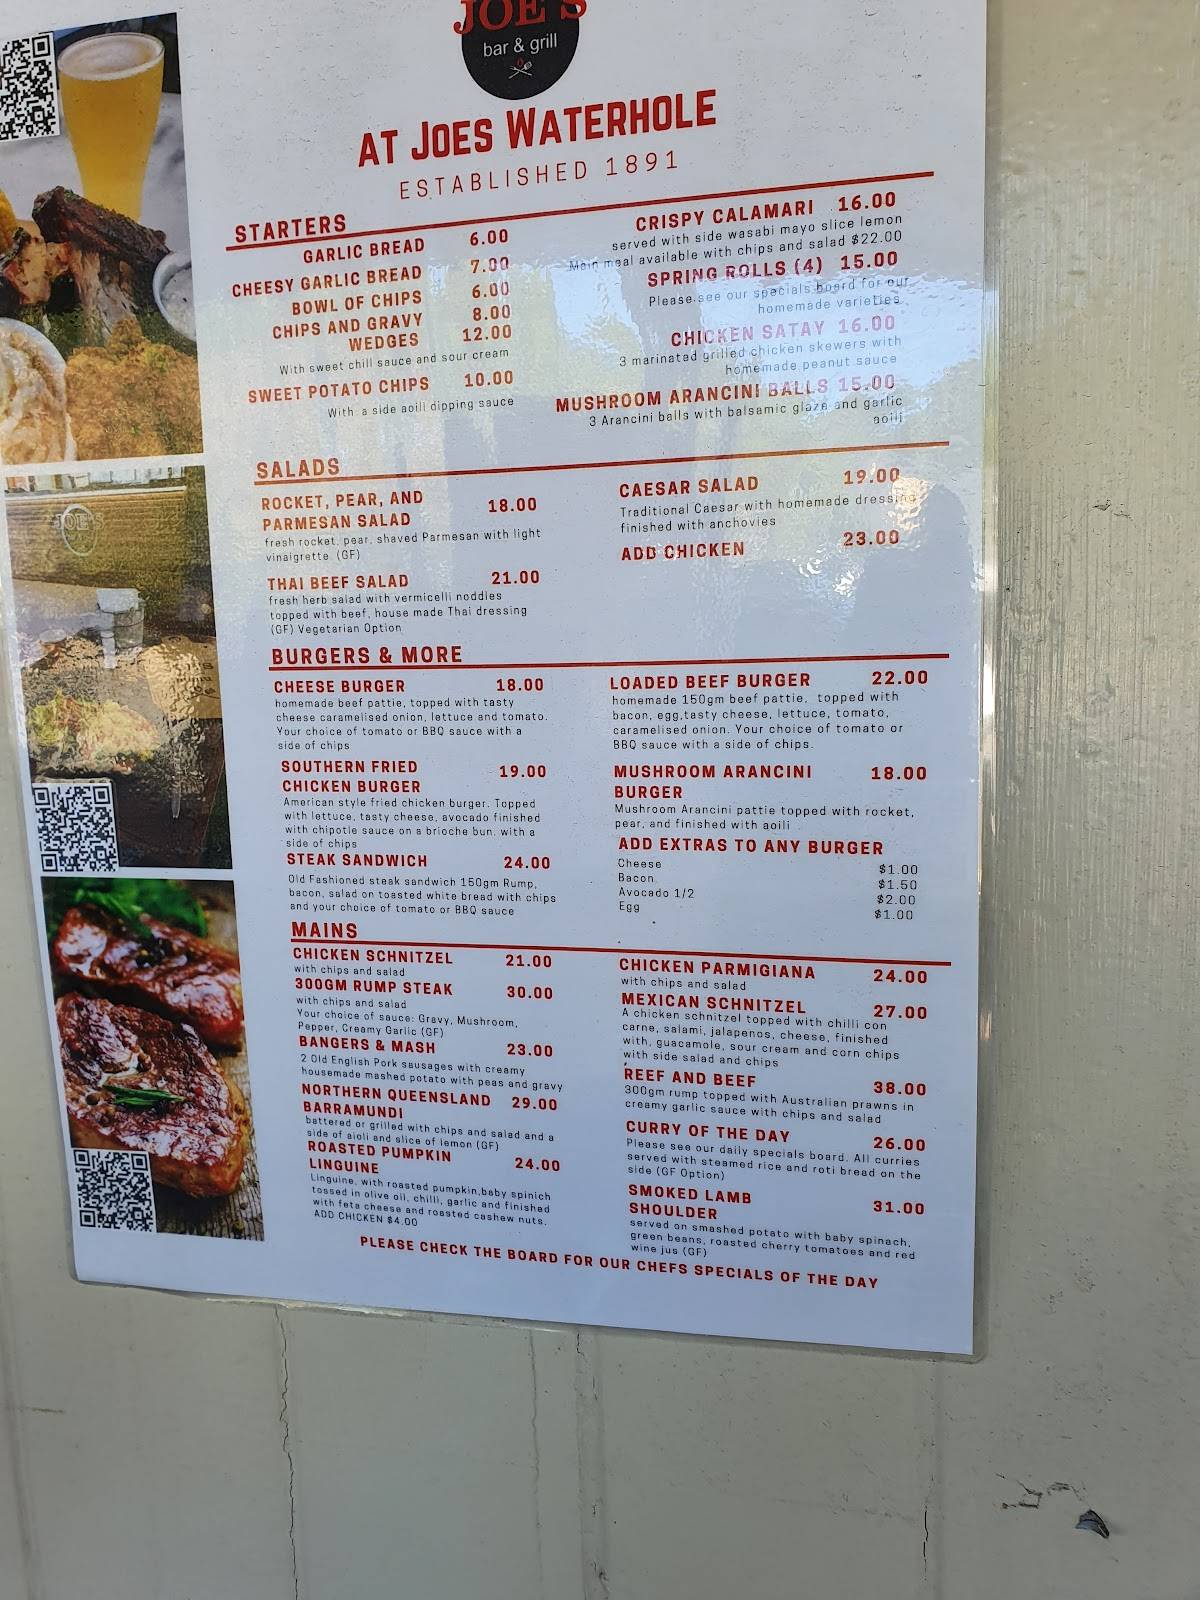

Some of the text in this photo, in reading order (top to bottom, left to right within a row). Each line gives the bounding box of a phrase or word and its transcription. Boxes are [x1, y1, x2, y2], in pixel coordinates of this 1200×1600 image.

[483, 33, 557, 57] bar & grill
[358, 130, 398, 167] AT
[399, 150, 679, 200] ESTABLISHED 1891
[635, 191, 896, 232] CRISPY CALAMARI 16.00
[235, 213, 346, 244] STARTERS
[612, 215, 902, 251] served with side wasabi mayo slice lemon
[303, 228, 508, 264] GARLIC BREAD 6.00
[232, 256, 509, 298] CHEESY GARLIC BREAD 7.00
[647, 250, 898, 288] SPRING ROLLS (4) 15.00
[292, 281, 510, 316] BOWL OF CHIPS 6.00
[272, 304, 511, 340] CHIPS AND GRAVY 8.00
[671, 313, 895, 347] CHICKEN SATAY 16.00
[348, 324, 512, 352] WEDGES 12.00
[279, 349, 509, 376] With sweet chill sauce and sour cream
[248, 369, 513, 404] SWEET POTATO CHIPS 10.00
[256, 457, 340, 480] SALADS
[619, 467, 900, 498] CAESAR SALAD 19.00
[261, 490, 537, 513] ROCKET, PEAR, AND 18.00
[263, 512, 411, 532] PARMESAN SALAD
[620, 516, 776, 534] finished with anchovies
[267, 570, 540, 591] THAI BEEF SALAD 21.00
[270, 609, 309, 622] topped
[312, 608, 337, 619] with
[374, 607, 409, 618] house
[413, 606, 444, 617] made
[447, 606, 472, 617] Thai
[476, 605, 527, 617] dressing
[271, 645, 462, 665] BURGERS & MORE
[274, 677, 544, 694] CHEESE BURGER 18.00
[610, 670, 928, 690] LOADED BEEF BURGER 22.00
[276, 712, 316, 722] cheese
[319, 711, 388, 722] caramelised
[431, 711, 473, 722] lettuce
[477, 711, 498, 722] and
[612, 724, 687, 735] caramelised
[735, 723, 764, 734] Your
[768, 723, 812, 734] choice
[817, 722, 831, 734] of
[836, 723, 885, 734] tomato
[890, 725, 903, 733] or
[618, 837, 883, 855] ADD EXTRAS TO ANY BURGER
[617, 857, 918, 875] Cheese $1.00
[618, 872, 917, 891] Bacon $1.50
[618, 886, 916, 905] Avocado 1/2 $2.00
[619, 900, 913, 921] Egg $1.00
[291, 921, 358, 939] MAINS
[293, 947, 552, 968] CHICKEN SCHNITZEL 21.00
[293, 963, 405, 977] with chips and salad
[619, 957, 928, 984] CHICKEN PARMIGIANA 24.00
[621, 992, 927, 1020] MEXICAN SCHNITZEL 27.00
[624, 1067, 926, 1096] REEF AND BEEF 38.00
[301, 1083, 558, 1111] NORTHERN QUEENSLAND 29.00
[624, 1084, 914, 1112] 300gm rump topped with Australian prawns in
[360, 1235, 878, 1289] PLEASE CHECK THE BOARD FOR OUR CHEFS SPECIALS OF THE DAY
